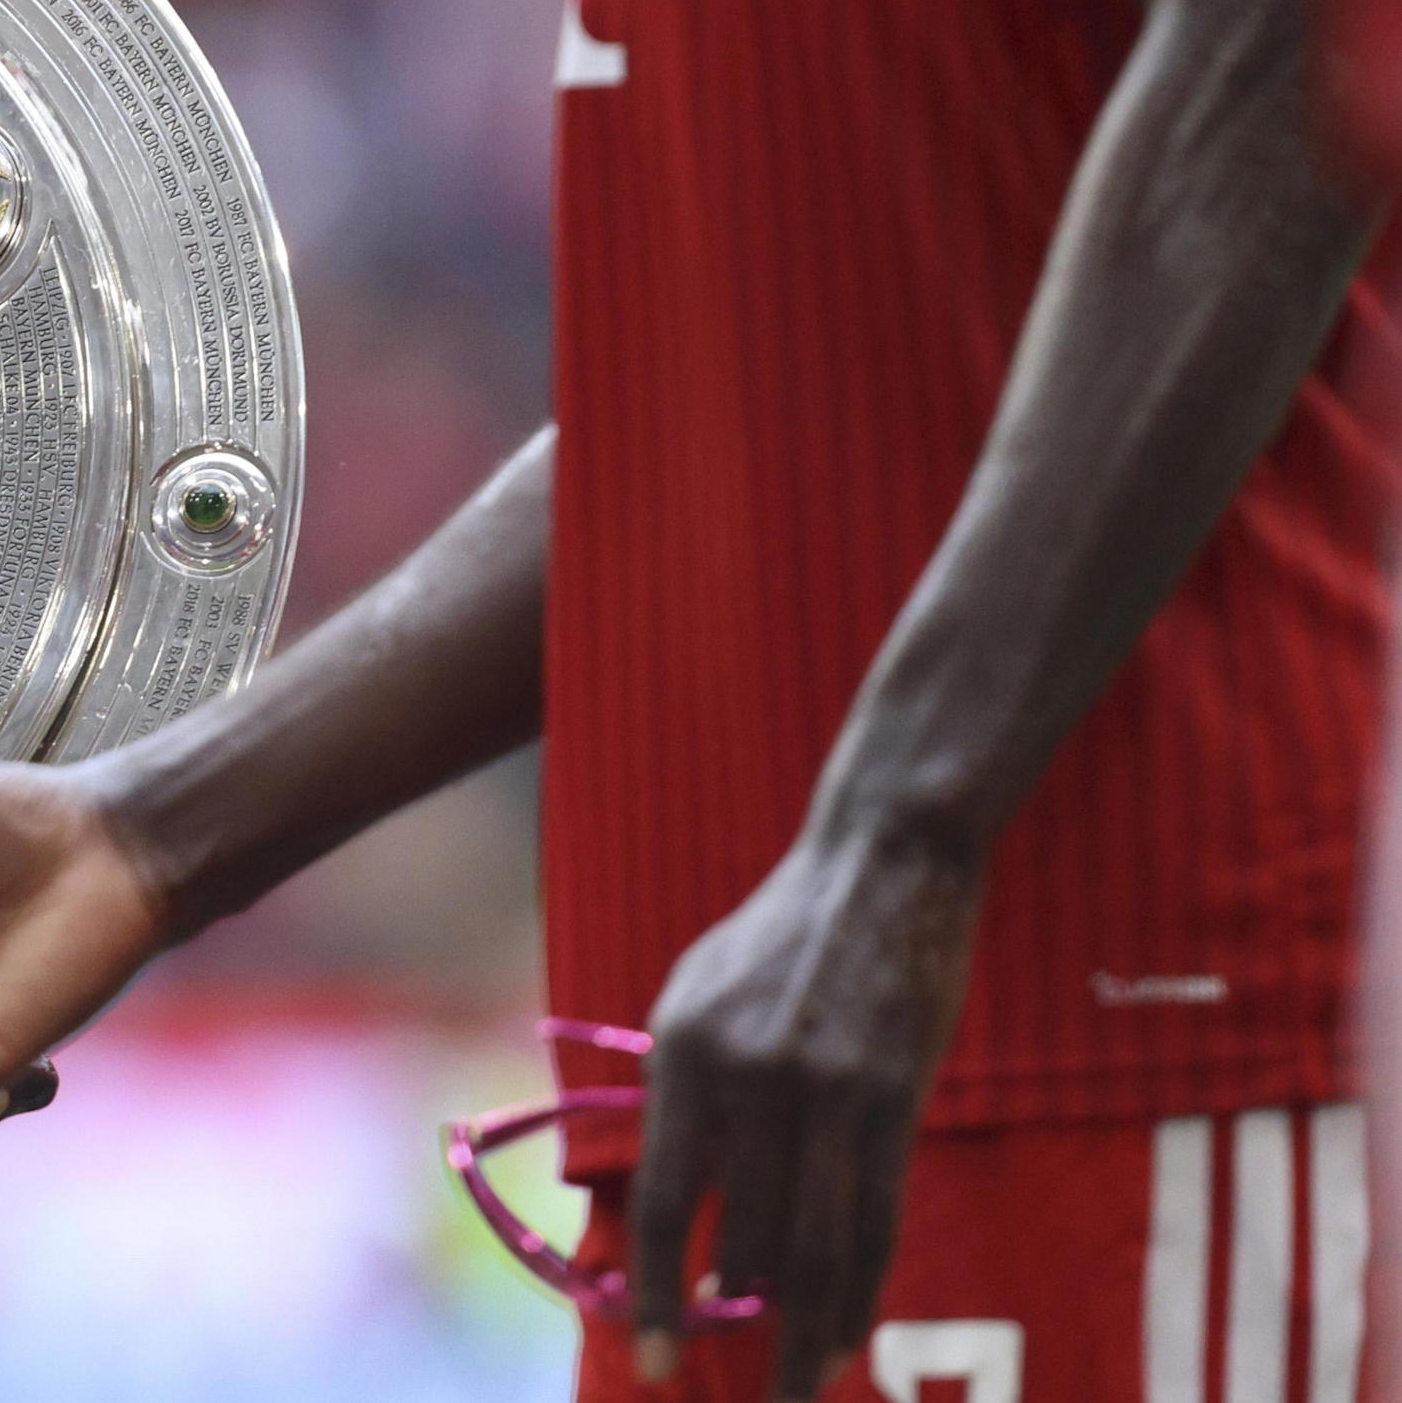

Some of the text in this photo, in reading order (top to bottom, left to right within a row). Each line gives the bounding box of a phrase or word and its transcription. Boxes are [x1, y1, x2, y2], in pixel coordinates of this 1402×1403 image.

[60, 8, 181, 200] 2016 FC BAYERN MÜNCHEN
[98, 11, 119, 34] FC
[114, 32, 159, 92] BAYERN
[152, 93, 199, 174] MÜNCHEN
[133, 13, 155, 37] FC
[148, 35, 193, 98] BAYERN
[186, 99, 232, 184] MÜNCHEN
[174, 209, 223, 425] 2017 FC BAYERN MÜNCHEN
[194, 184, 248, 422] 2002 BV BORUSSIA DORTMUND
[226, 197, 276, 421] 1987 FC BAYERN MÜNCHEN
[17, 557, 57, 642] VIKTORIA
[47, 519, 66, 552] 1908
[147, 583, 200, 710] 2018 FC BAYERN
[193, 595, 223, 661] 2003 FC
[223, 594, 250, 653] 1988 SV
